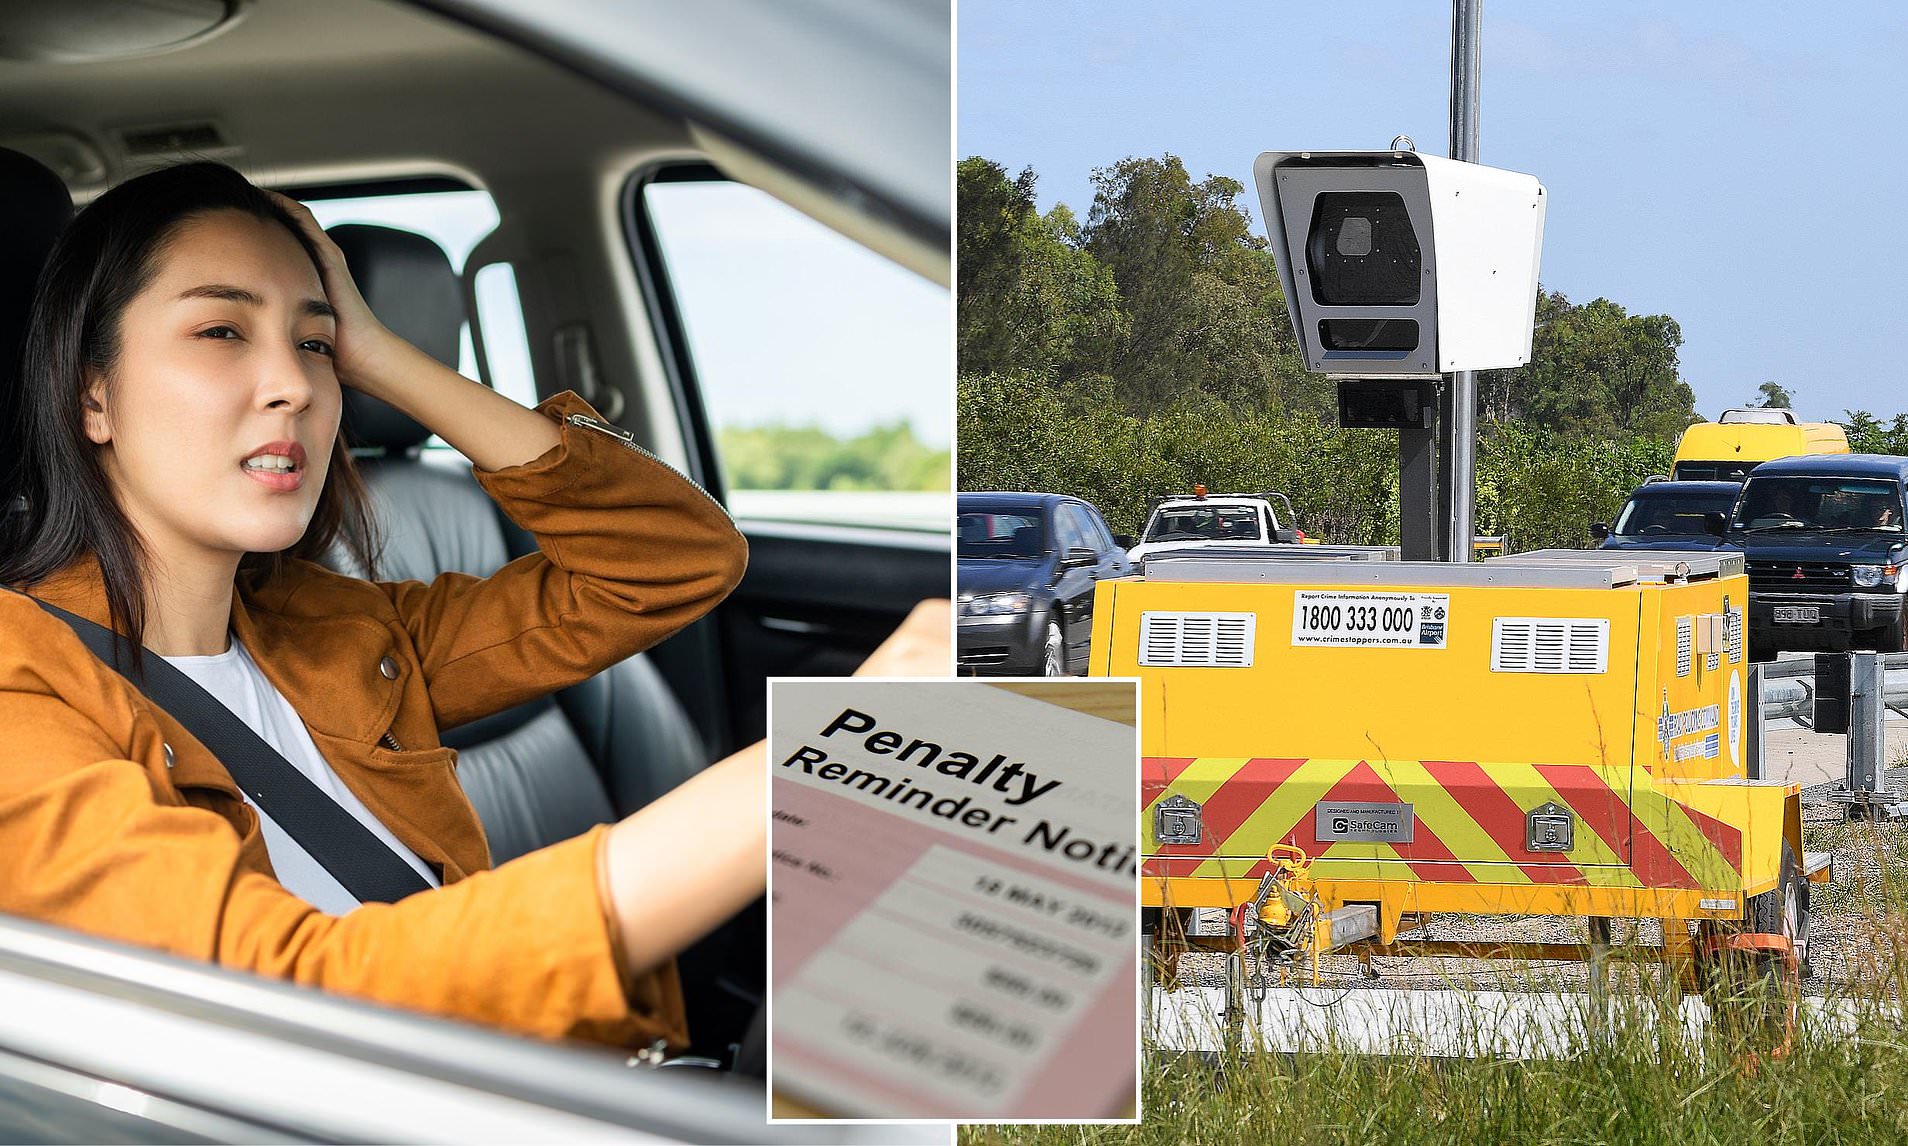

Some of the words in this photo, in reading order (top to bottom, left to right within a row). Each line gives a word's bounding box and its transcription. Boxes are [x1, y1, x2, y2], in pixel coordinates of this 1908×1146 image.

[1370, 594, 1408, 602] Anonymously
[1302, 605, 1341, 631] 1800
[1346, 606, 1377, 632] 333
[1382, 607, 1414, 633] 000
[1298, 634, 1413, 645] www.crimestoppers.com.au
[819, 708, 1062, 806] Penalty
[782, 745, 1018, 834] Reminder
[1350, 820, 1398, 830] SafeCam
